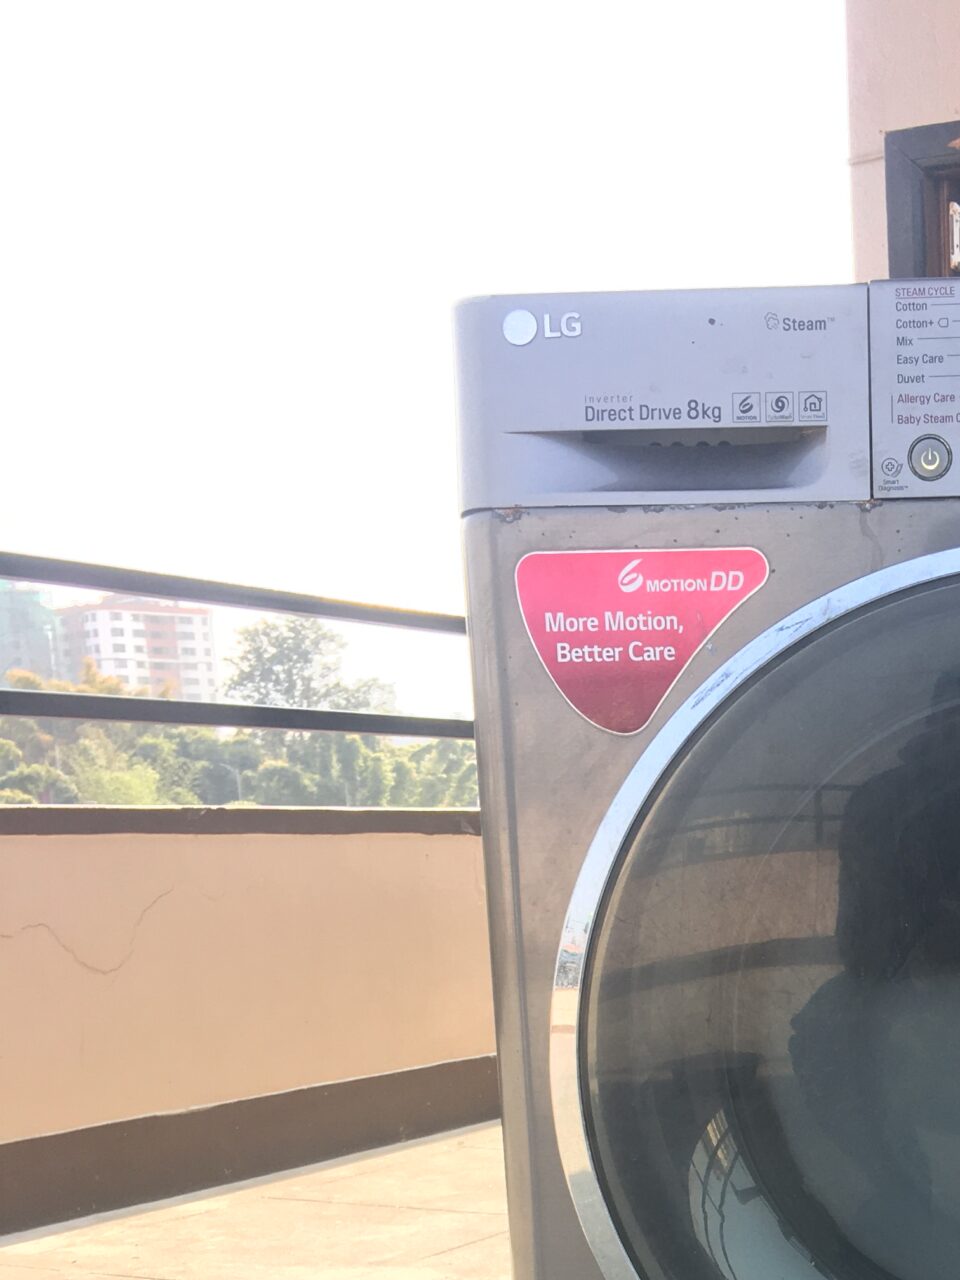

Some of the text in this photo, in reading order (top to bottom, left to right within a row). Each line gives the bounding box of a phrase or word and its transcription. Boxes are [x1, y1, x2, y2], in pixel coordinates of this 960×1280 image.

[895, 286, 955, 297] STEAM CYCLE
[896, 301, 927, 311] Cotton
[544, 312, 582, 338] LG
[896, 318, 934, 329] Cotton+
[896, 336, 913, 346] Mix
[897, 353, 943, 366] Easy Care
[897, 373, 925, 384] Duvet
[897, 392, 955, 405] Allergy Care
[585, 399, 722, 422] Direct Drive 8kg
[897, 413, 921, 425] Baby
[924, 412, 954, 423] Steam
[647, 579, 707, 592] MOTION
[710, 571, 744, 591] DD
[545, 611, 683, 633] More Motion,
[556, 641, 675, 663] Better Care
